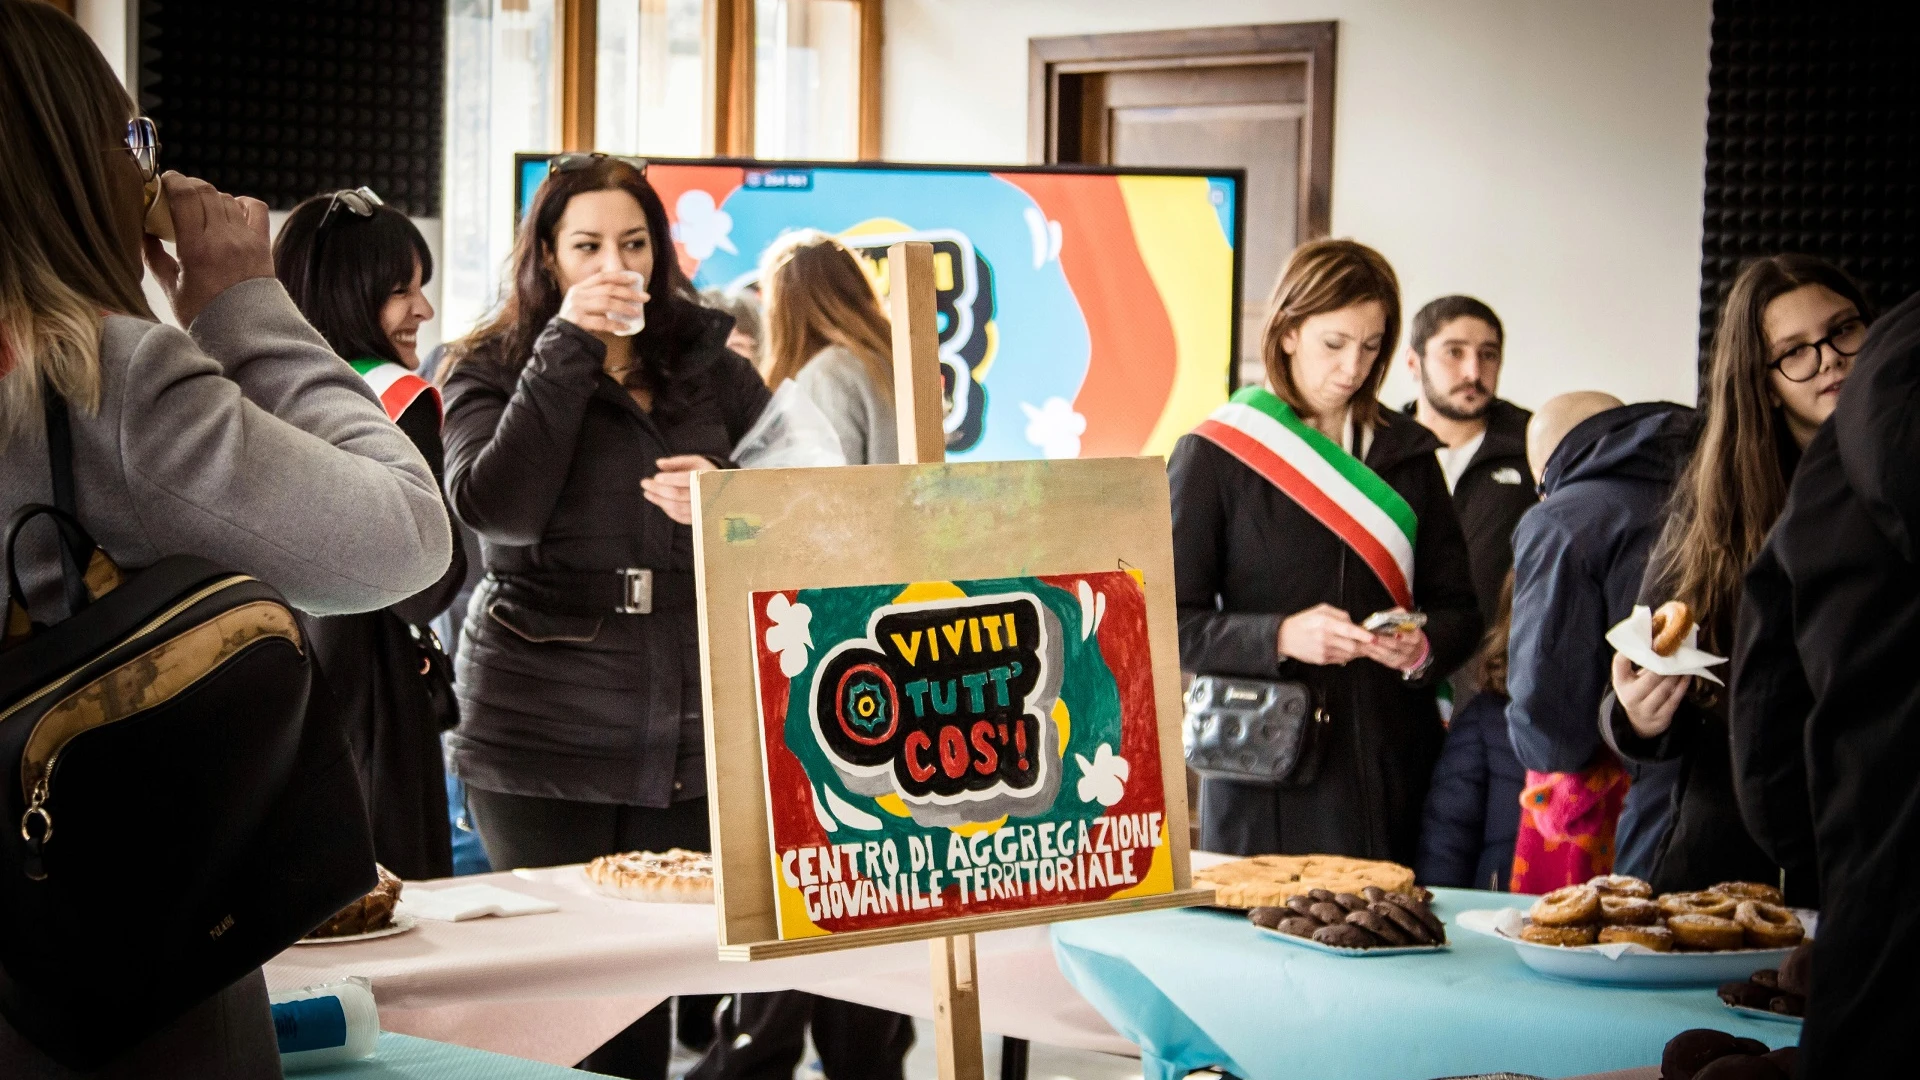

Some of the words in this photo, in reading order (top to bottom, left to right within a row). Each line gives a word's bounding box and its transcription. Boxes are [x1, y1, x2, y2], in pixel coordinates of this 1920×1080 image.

[890, 613, 1017, 667] VIVITI
[905, 661, 1023, 718] TUTT'
[782, 838, 900, 889] CENTRO
[908, 835, 935, 873] DI
[947, 812, 1163, 869] AGGREGAZIONE
[803, 869, 943, 922] GIOVANILE
[952, 849, 1138, 905] TERRITORIALE
